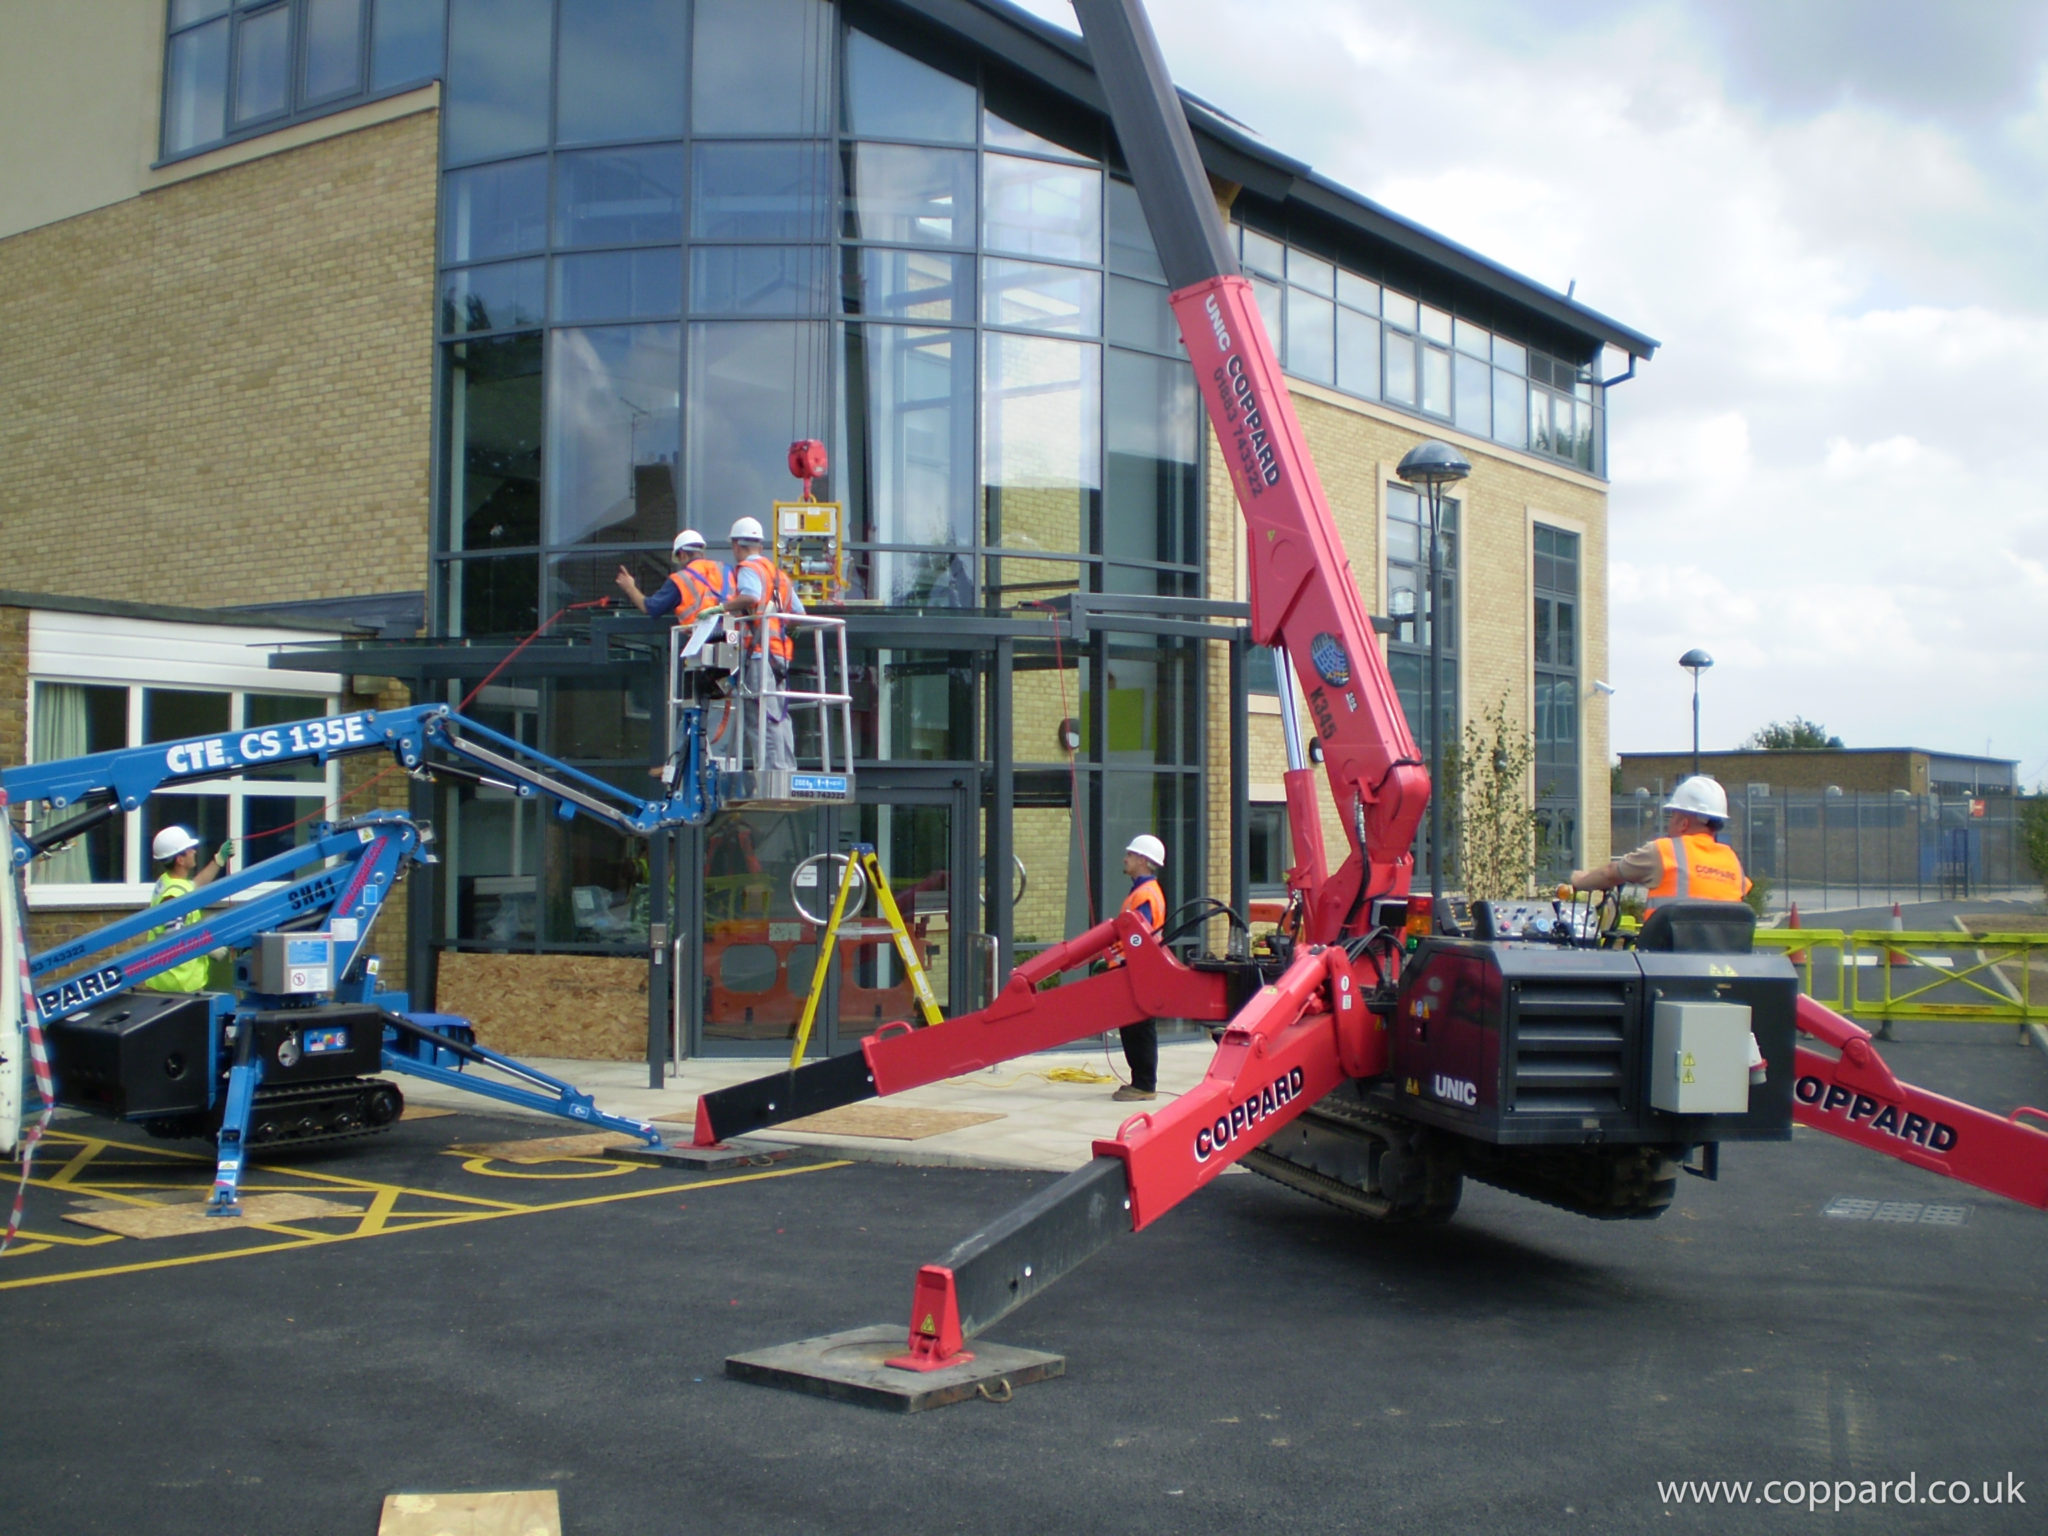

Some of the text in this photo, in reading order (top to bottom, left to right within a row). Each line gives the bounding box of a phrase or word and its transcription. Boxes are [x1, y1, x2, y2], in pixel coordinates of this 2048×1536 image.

[1205, 293, 1280, 487] UNIC COPPARD
[166, 716, 364, 773] CTE CS 135E
[288, 877, 336, 910] SH41
[37, 966, 123, 1019] PARD
[1194, 1065, 1304, 1163] COPPARD
[1435, 1074, 1477, 1106] UNIC
